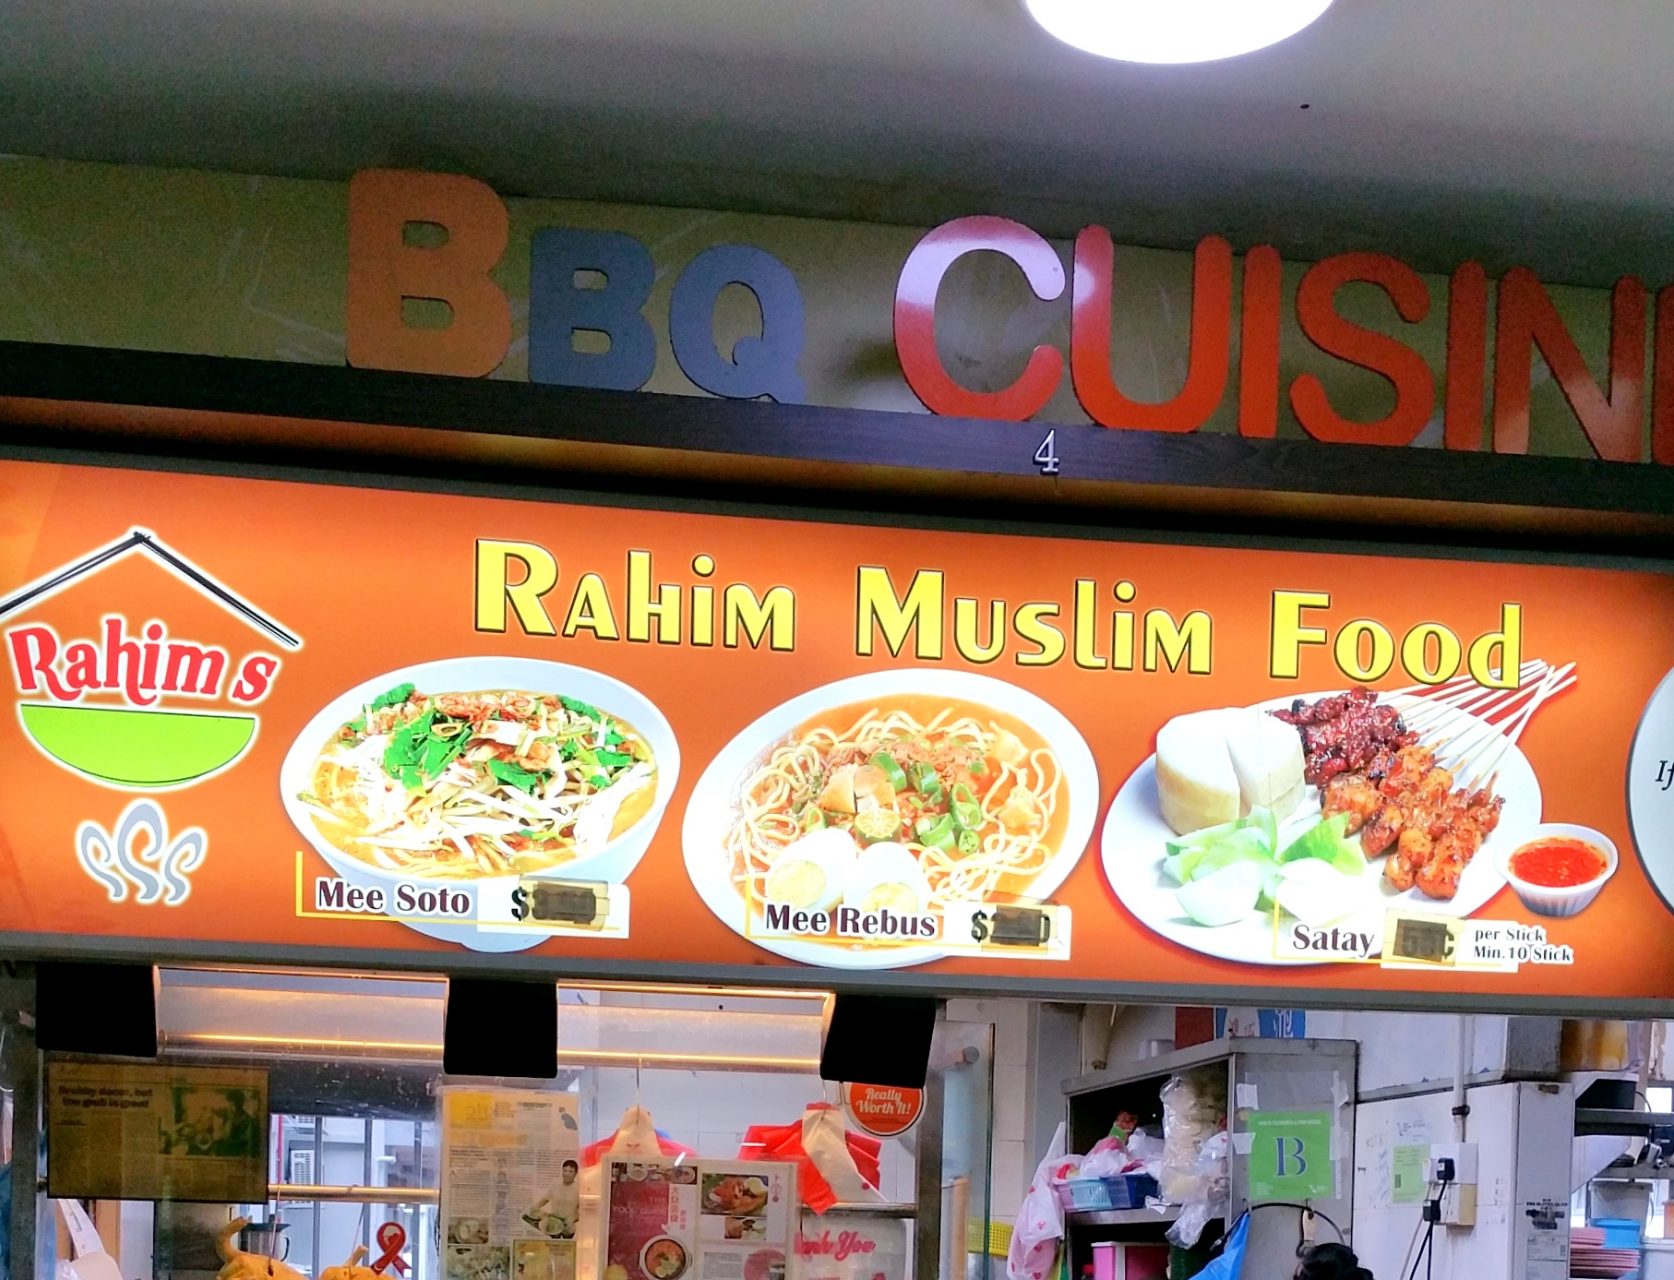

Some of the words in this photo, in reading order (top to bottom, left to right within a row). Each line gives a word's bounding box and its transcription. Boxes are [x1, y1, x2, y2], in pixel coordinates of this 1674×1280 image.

[346, 168, 806, 403] BBQ
[1032, 430, 1061, 474] 4
[1271, 589, 1522, 690] Food
[318, 880, 383, 910] Mee
[397, 884, 470, 914] Soto
[766, 904, 827, 933] Mee
[840, 909, 935, 937] Rebus
[1475, 929, 1501, 943] per
[1506, 926, 1544, 943] Stick
[1292, 924, 1375, 959] Satay
[1509, 946, 1528, 961] 10
[1532, 946, 1573, 963] Stick
[856, 1100, 895, 1115] Worth
[865, 1087, 902, 1103] Really
[1276, 1137, 1307, 1176] B
